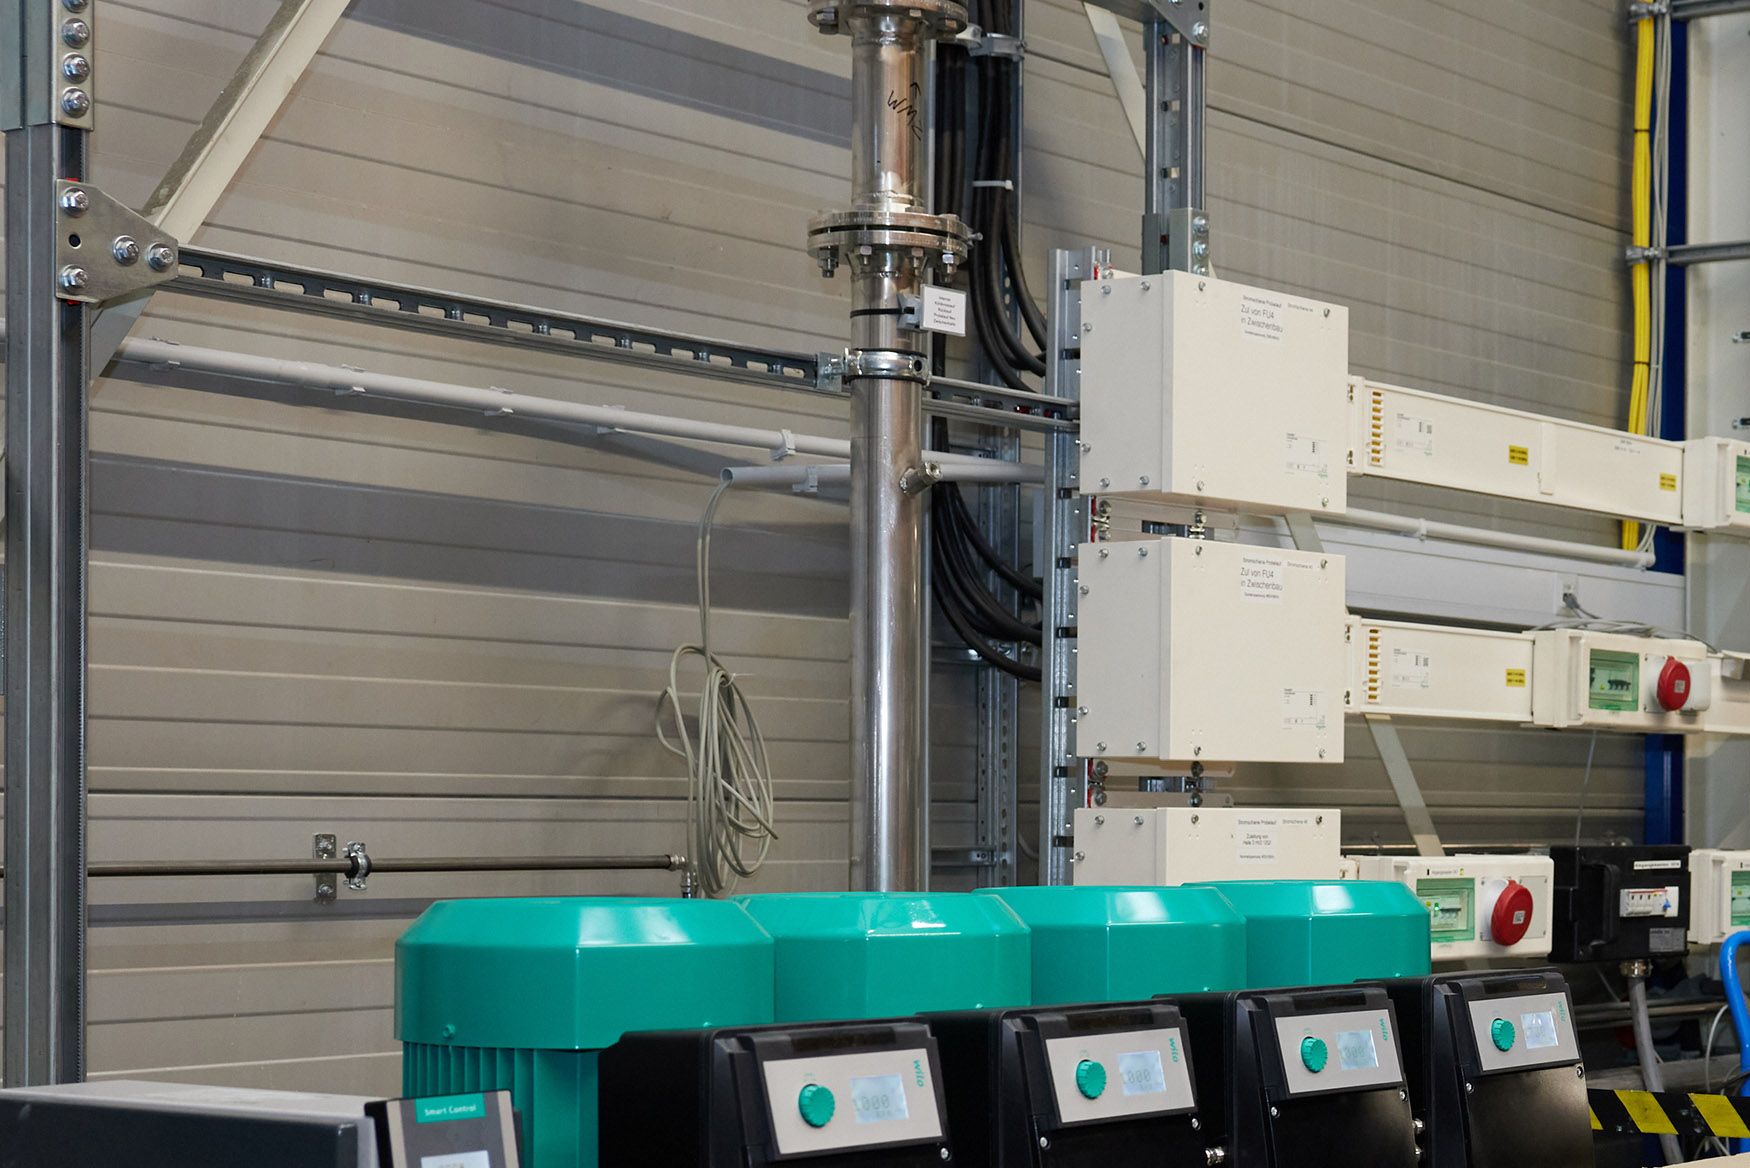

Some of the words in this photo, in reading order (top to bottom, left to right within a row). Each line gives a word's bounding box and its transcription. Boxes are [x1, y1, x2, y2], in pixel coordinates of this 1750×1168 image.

[1262, 569, 1274, 578] FU4
[1379, 1018, 1388, 1042] wilo
[1168, 1037, 1179, 1062] wilo
[913, 1059, 924, 1088] wilo
[424, 1108, 447, 1116] Smart
[448, 1104, 476, 1114] Control
